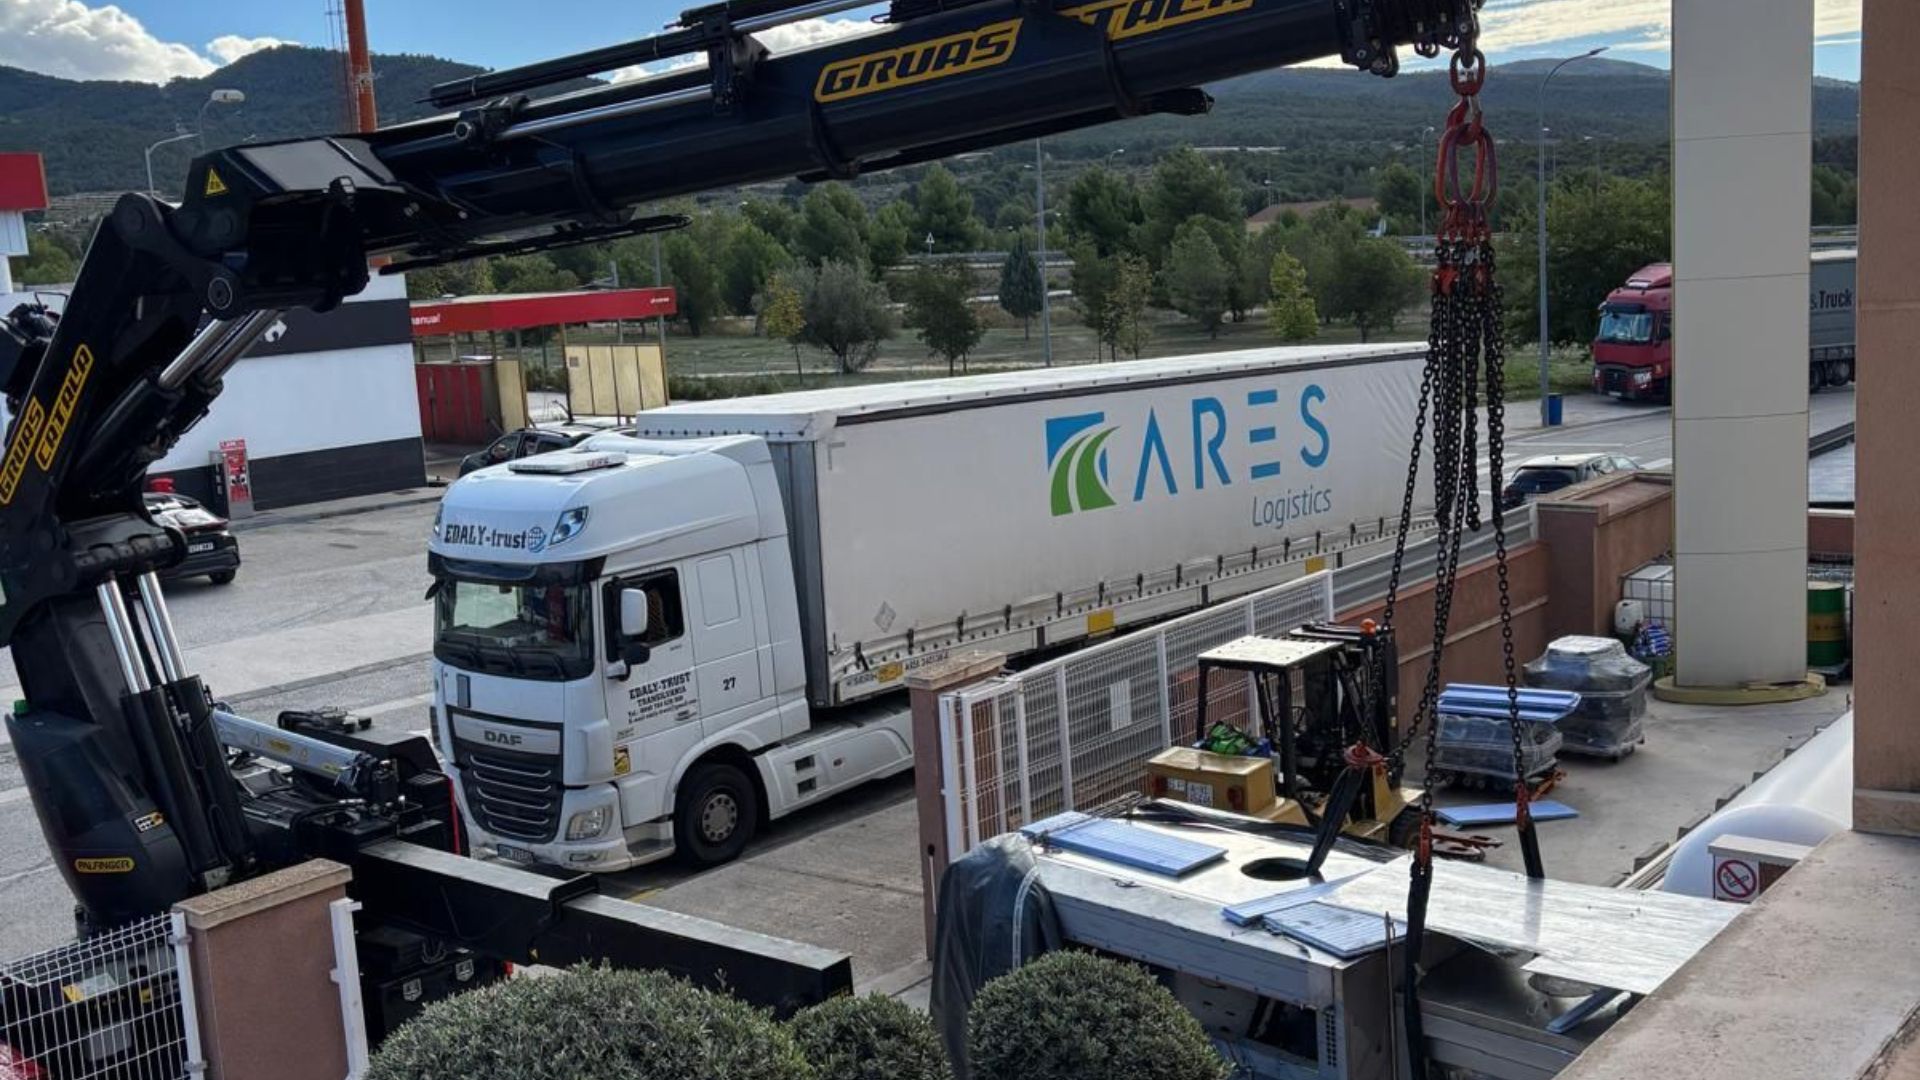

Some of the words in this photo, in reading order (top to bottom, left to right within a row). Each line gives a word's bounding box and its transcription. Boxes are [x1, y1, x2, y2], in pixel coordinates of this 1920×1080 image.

[820, 29, 1010, 95] GRUAS
[1819, 288, 1852, 309] Truck
[1133, 384, 1330, 501] ARES
[1252, 485, 1333, 530] Logistics
[444, 524, 527, 549] EDALY-trust
[628, 672, 691, 699] EDALY-TRUST
[722, 677, 736, 691] 27
[484, 730, 522, 745] DAF
